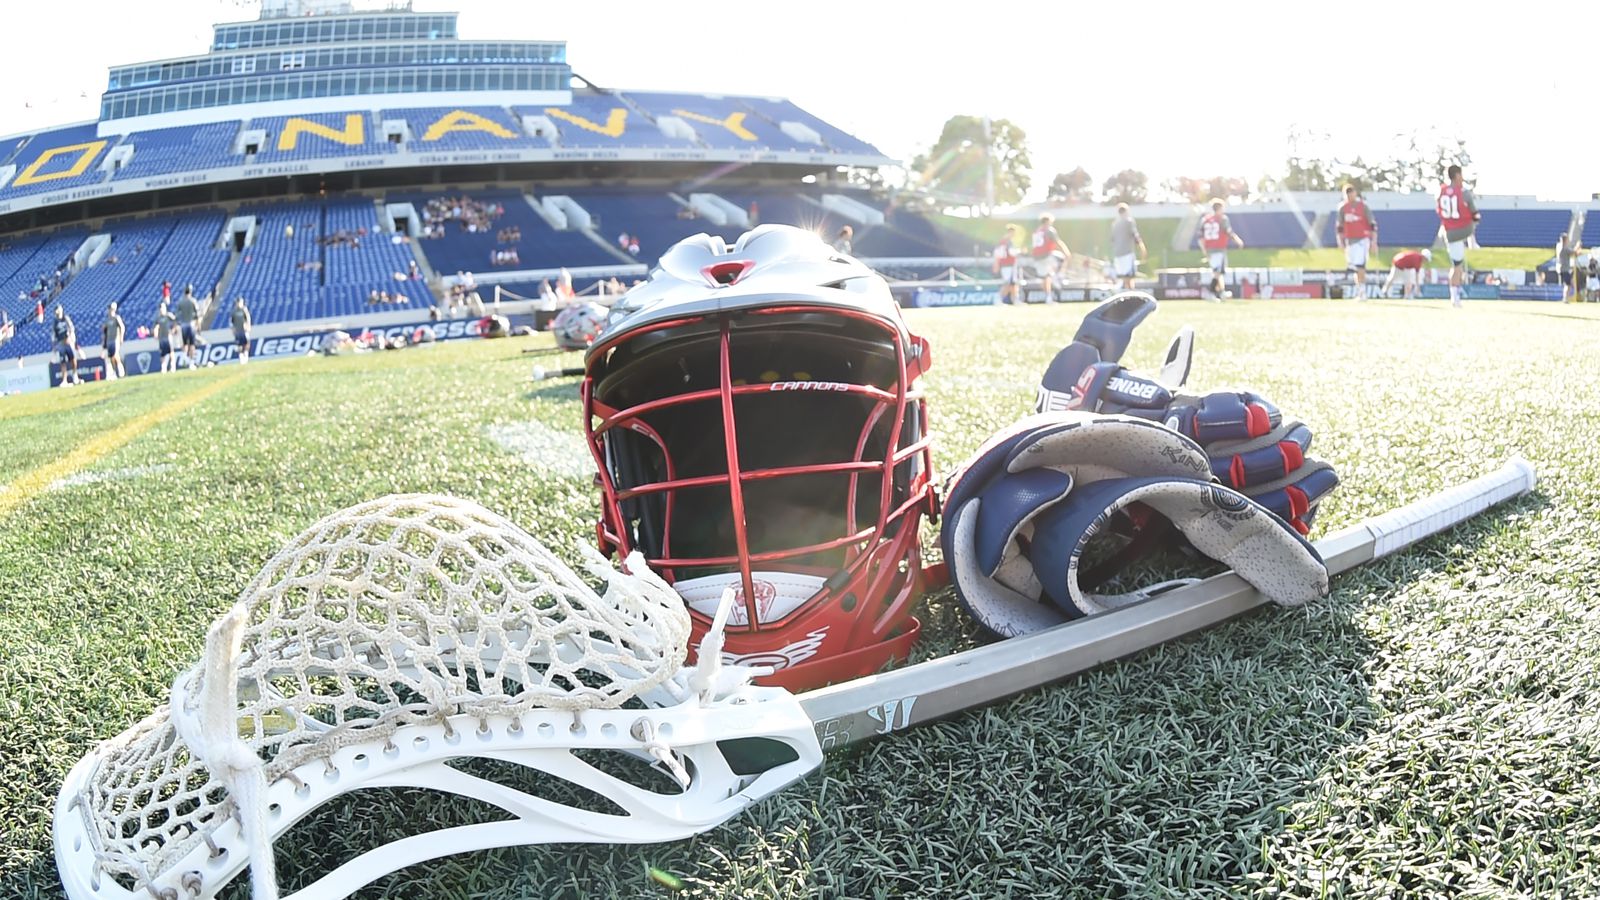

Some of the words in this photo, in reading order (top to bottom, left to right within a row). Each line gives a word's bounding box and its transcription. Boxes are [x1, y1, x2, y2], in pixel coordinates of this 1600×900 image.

[267, 164, 309, 174] PARALLEL
[344, 159, 385, 169] LEBANON
[72, 186, 114, 198] RESERVOIR
[1440, 195, 1460, 219] 91
[1203, 222, 1220, 240] 22
[254, 334, 326, 356] leagu
[361, 319, 482, 345] lcrsse
[770, 381, 849, 391] CANNONS
[1107, 376, 1157, 399] BRINE
